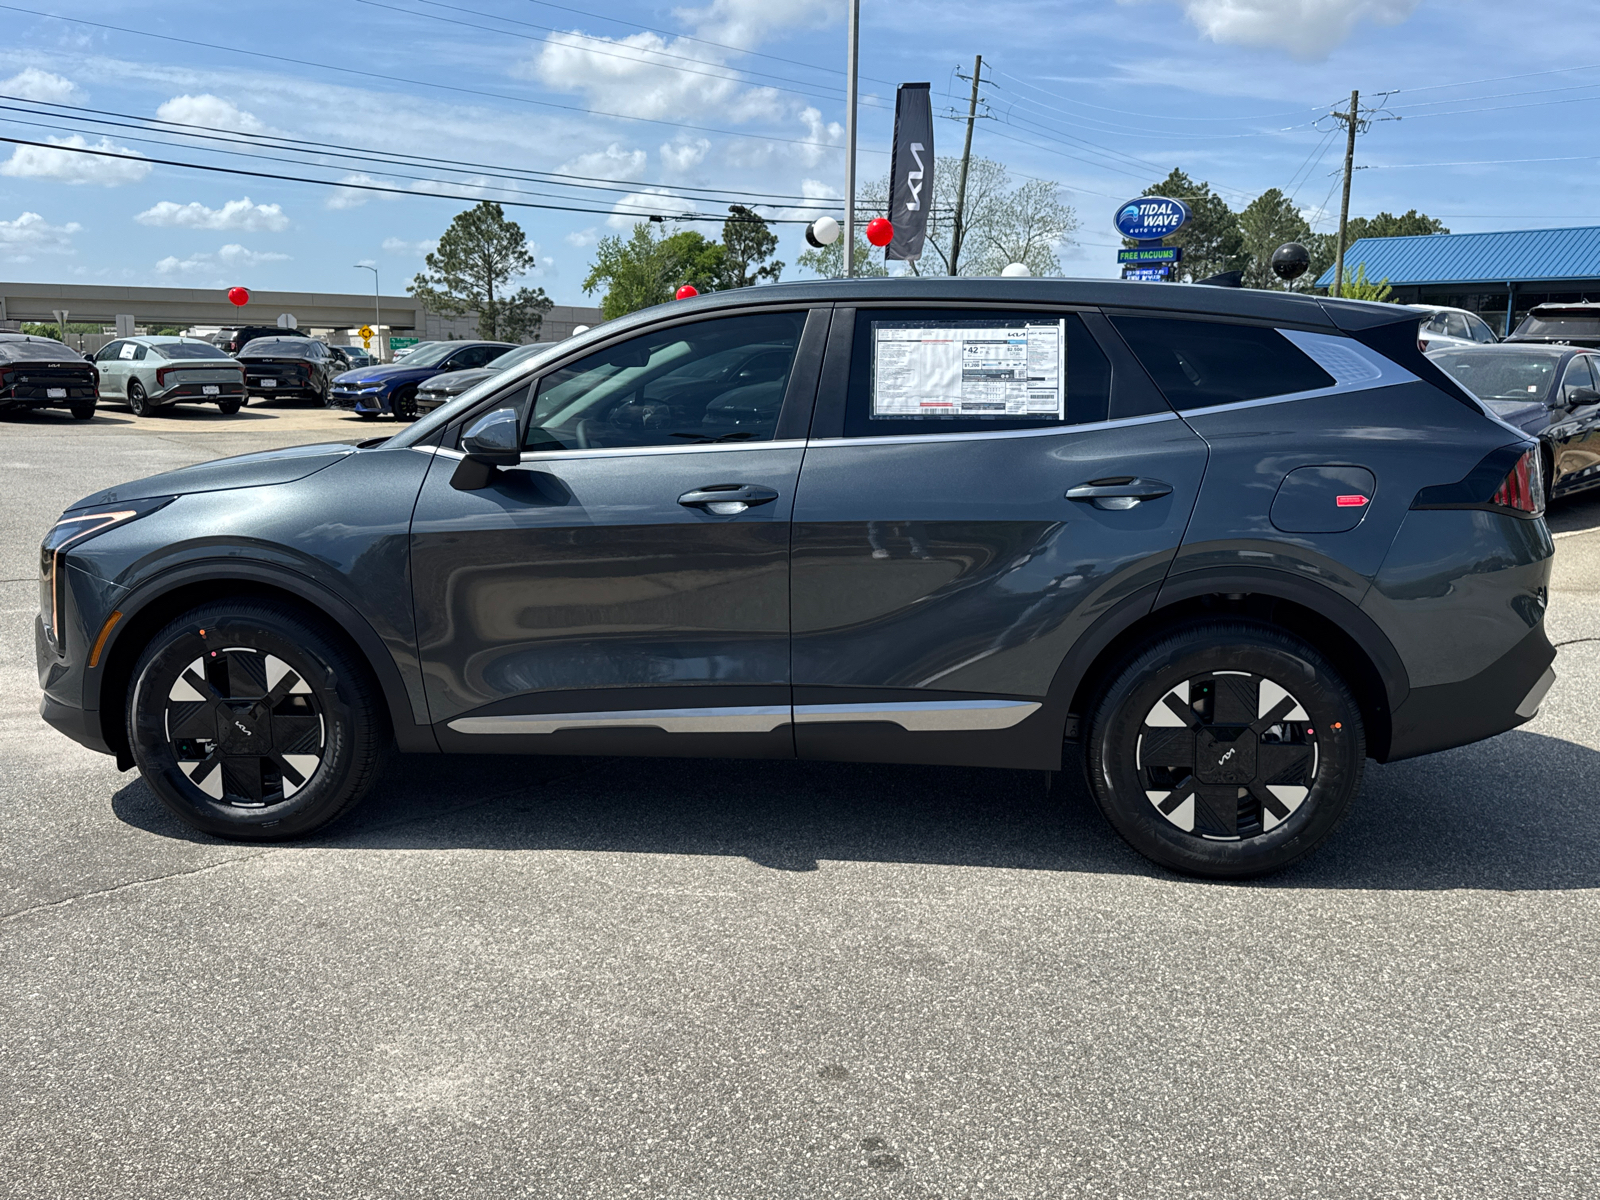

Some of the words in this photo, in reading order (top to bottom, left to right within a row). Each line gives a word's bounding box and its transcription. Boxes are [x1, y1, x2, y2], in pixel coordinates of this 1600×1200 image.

[906, 143, 925, 211] KIA
[1139, 203, 1173, 216] TIDAL
[1143, 214, 1180, 227] WAVE
[1119, 251, 1138, 260] FREE
[1139, 249, 1174, 260] VACUUMS
[967, 346, 979, 354] 42
